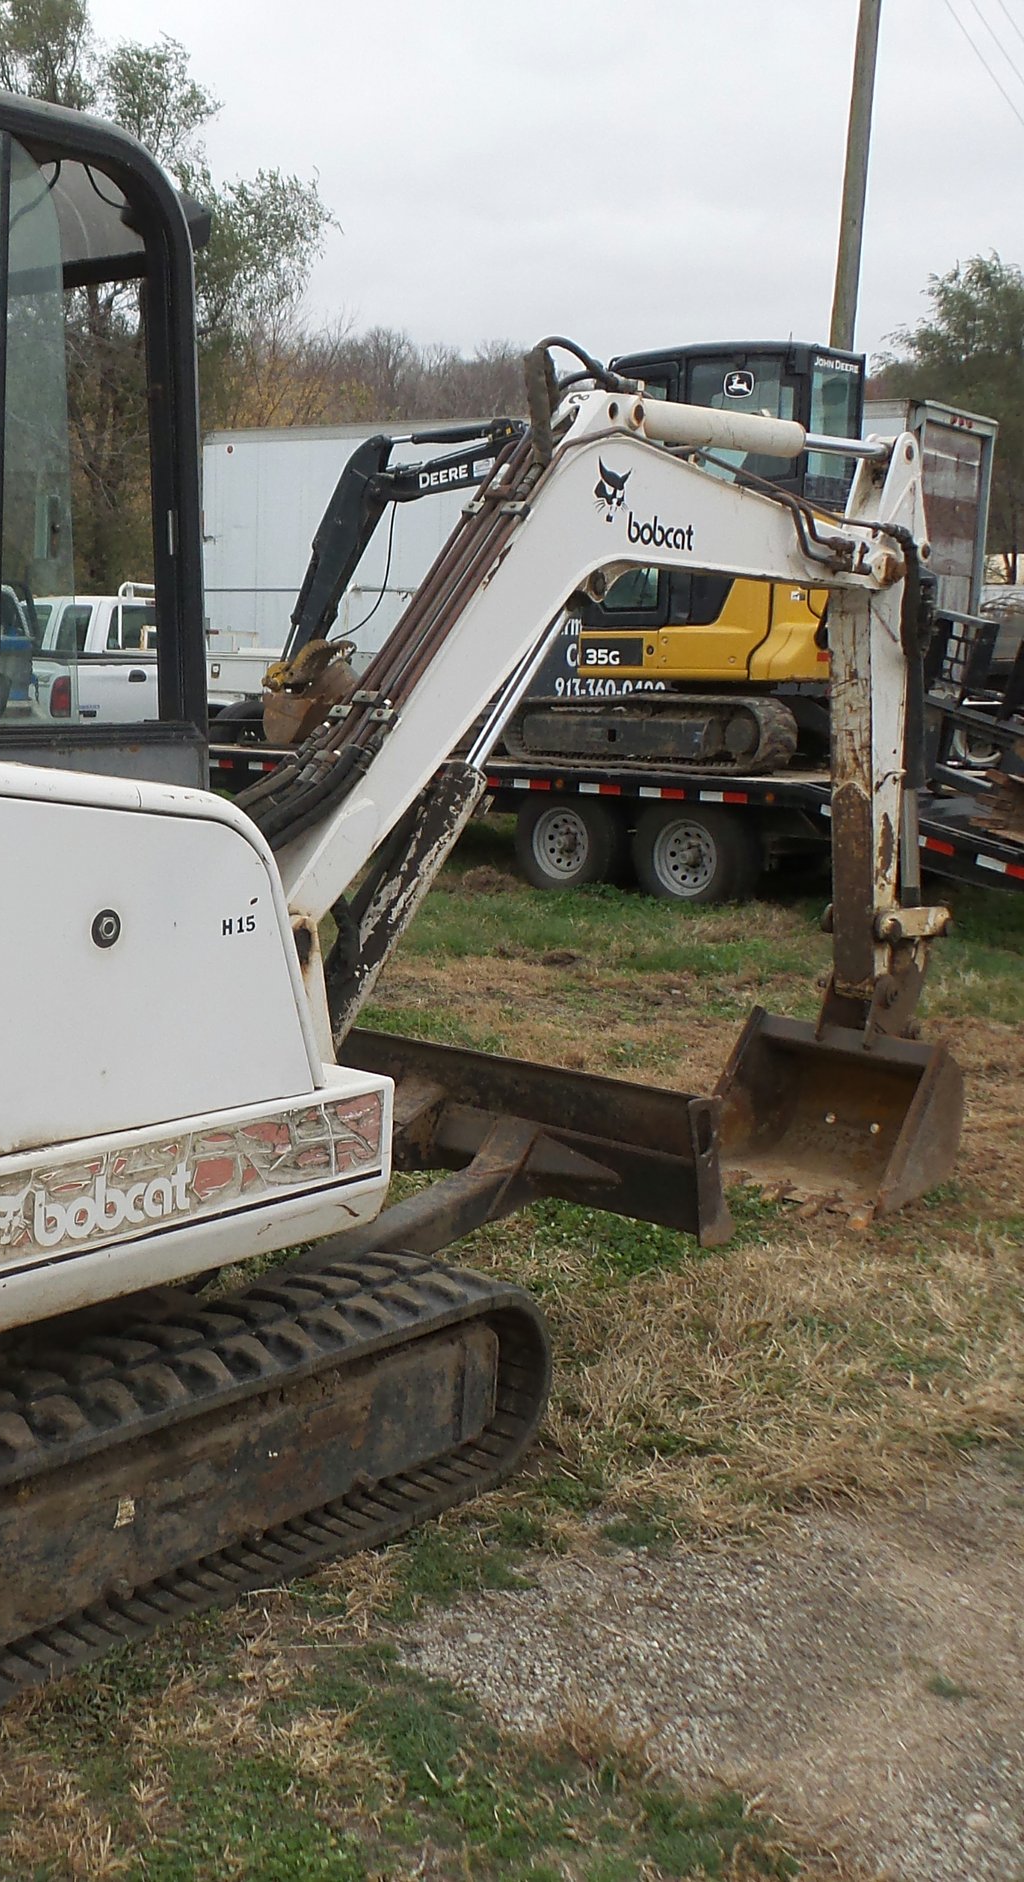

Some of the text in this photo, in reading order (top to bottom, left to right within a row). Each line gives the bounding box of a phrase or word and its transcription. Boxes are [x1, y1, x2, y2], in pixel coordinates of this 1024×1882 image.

[814, 355, 859, 374] JOHN DEERE
[418, 464, 469, 489] DEERE
[627, 511, 694, 551] bobcat
[585, 648, 620, 665] 35G
[33, 1162, 192, 1247] bobcat
